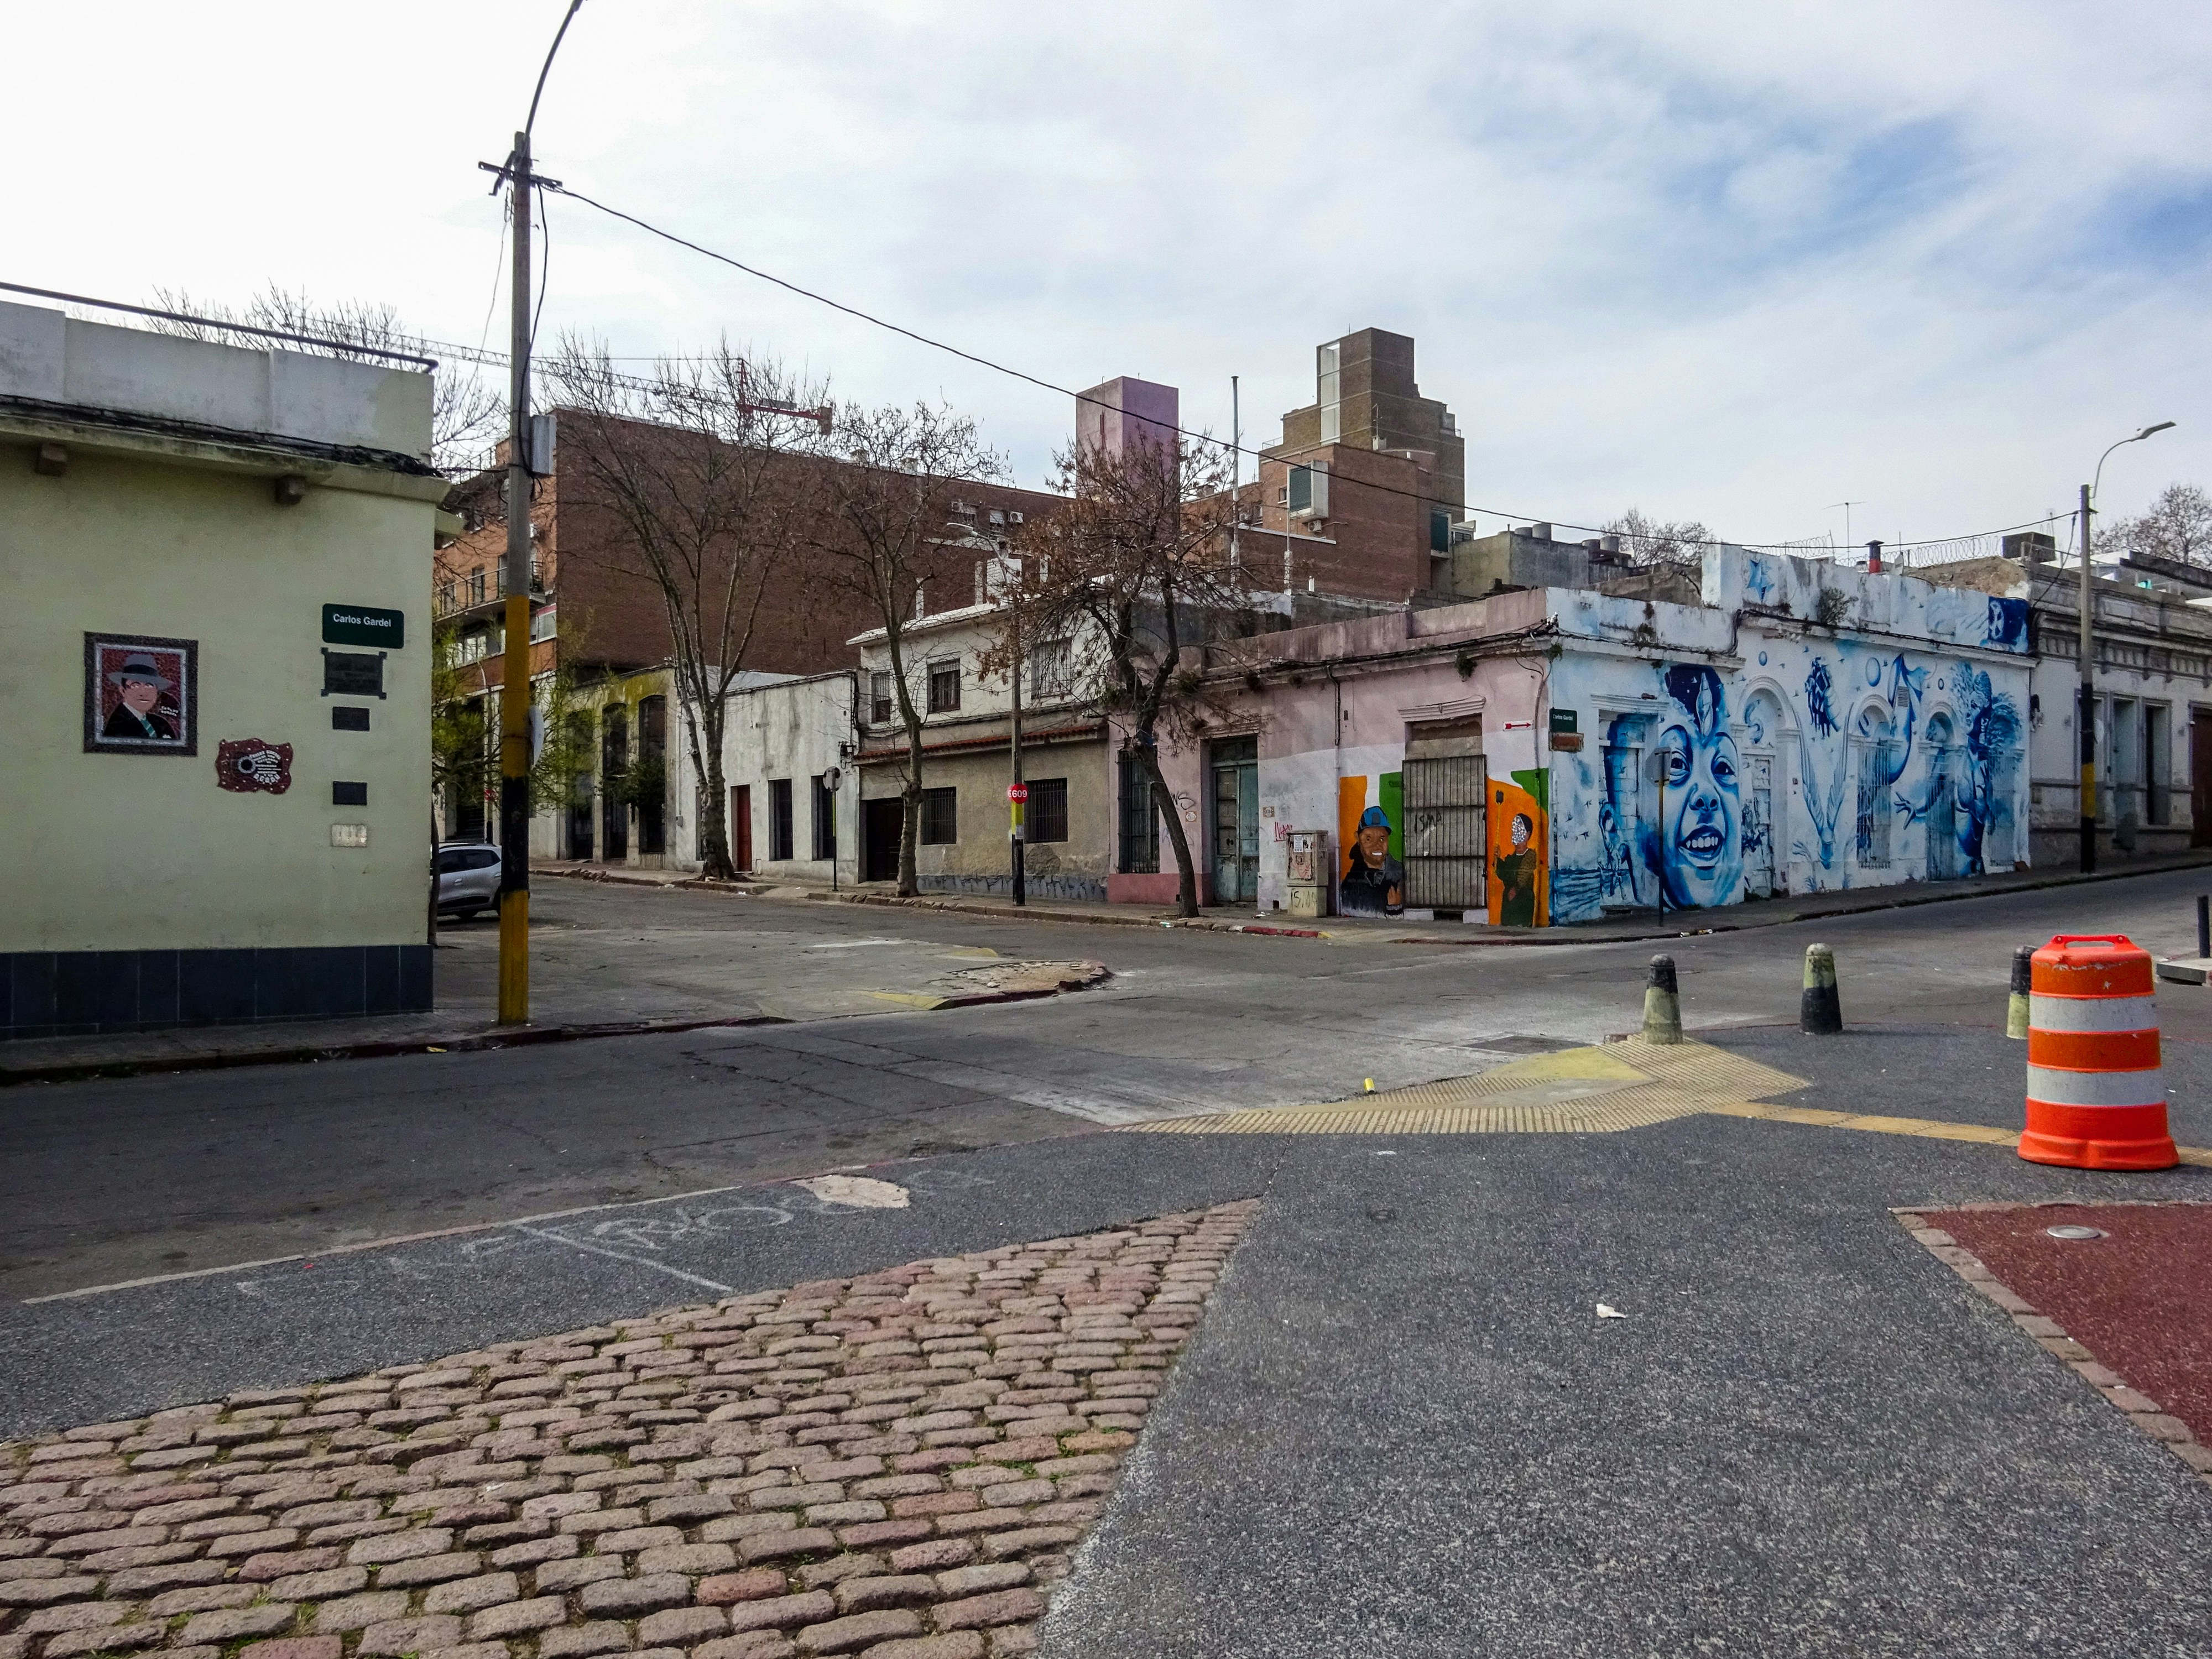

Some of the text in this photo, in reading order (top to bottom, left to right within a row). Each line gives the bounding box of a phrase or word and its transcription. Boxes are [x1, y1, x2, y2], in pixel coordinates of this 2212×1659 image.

[333, 613, 392, 627] Carlos Gardel
[1012, 789, 1027, 798] 609
